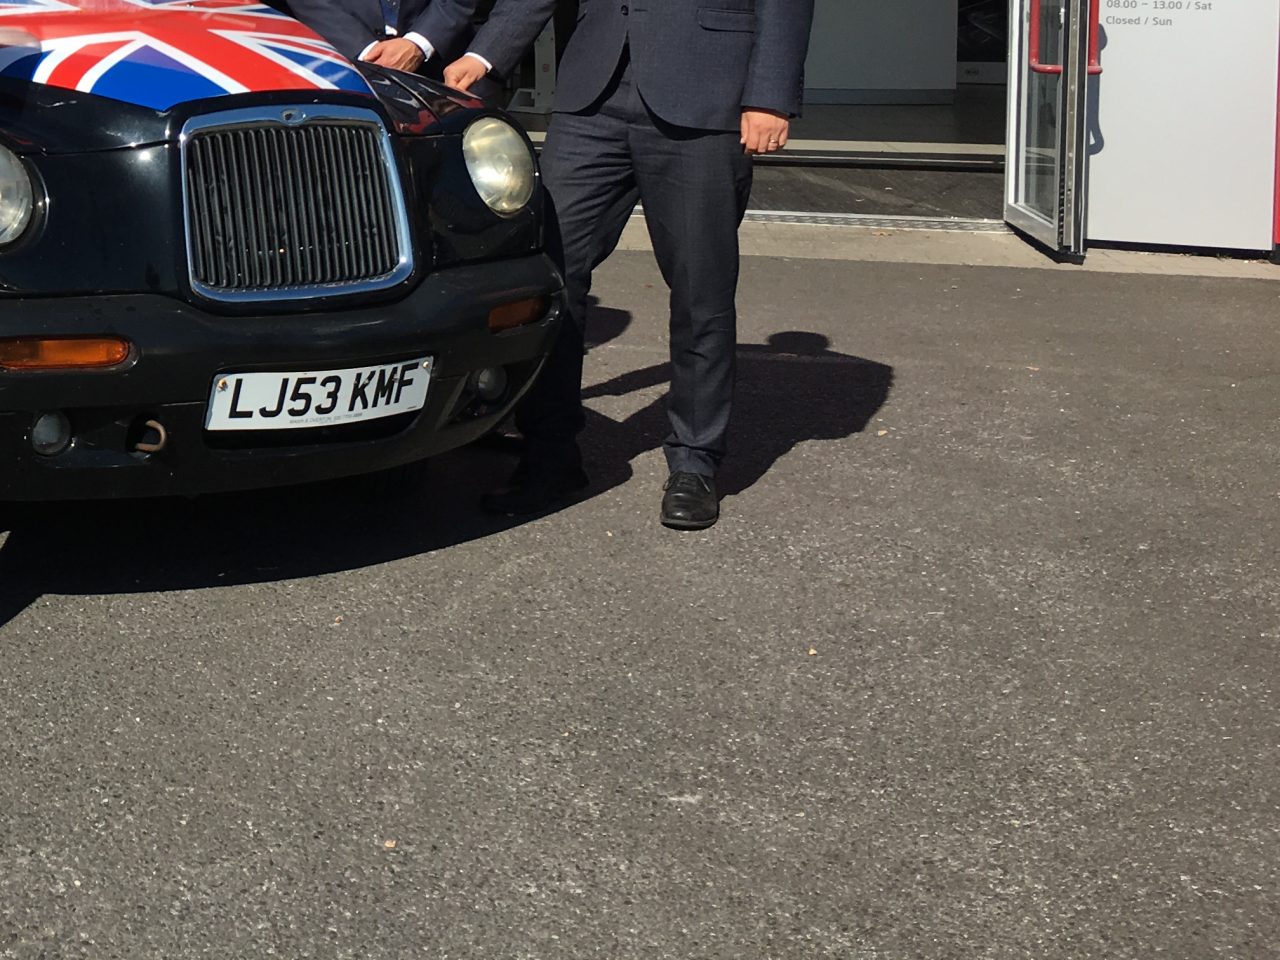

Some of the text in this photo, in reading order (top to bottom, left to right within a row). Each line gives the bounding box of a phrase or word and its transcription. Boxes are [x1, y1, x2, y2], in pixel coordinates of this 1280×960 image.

[1106, 0, 1137, 9] 08.00
[1153, 0, 1183, 10] 13.00
[1194, 1, 1212, 10] Sat
[1105, 16, 1141, 25] Closed
[1153, 17, 1173, 26] Sun
[228, 362, 420, 419] LJ53 KMF
